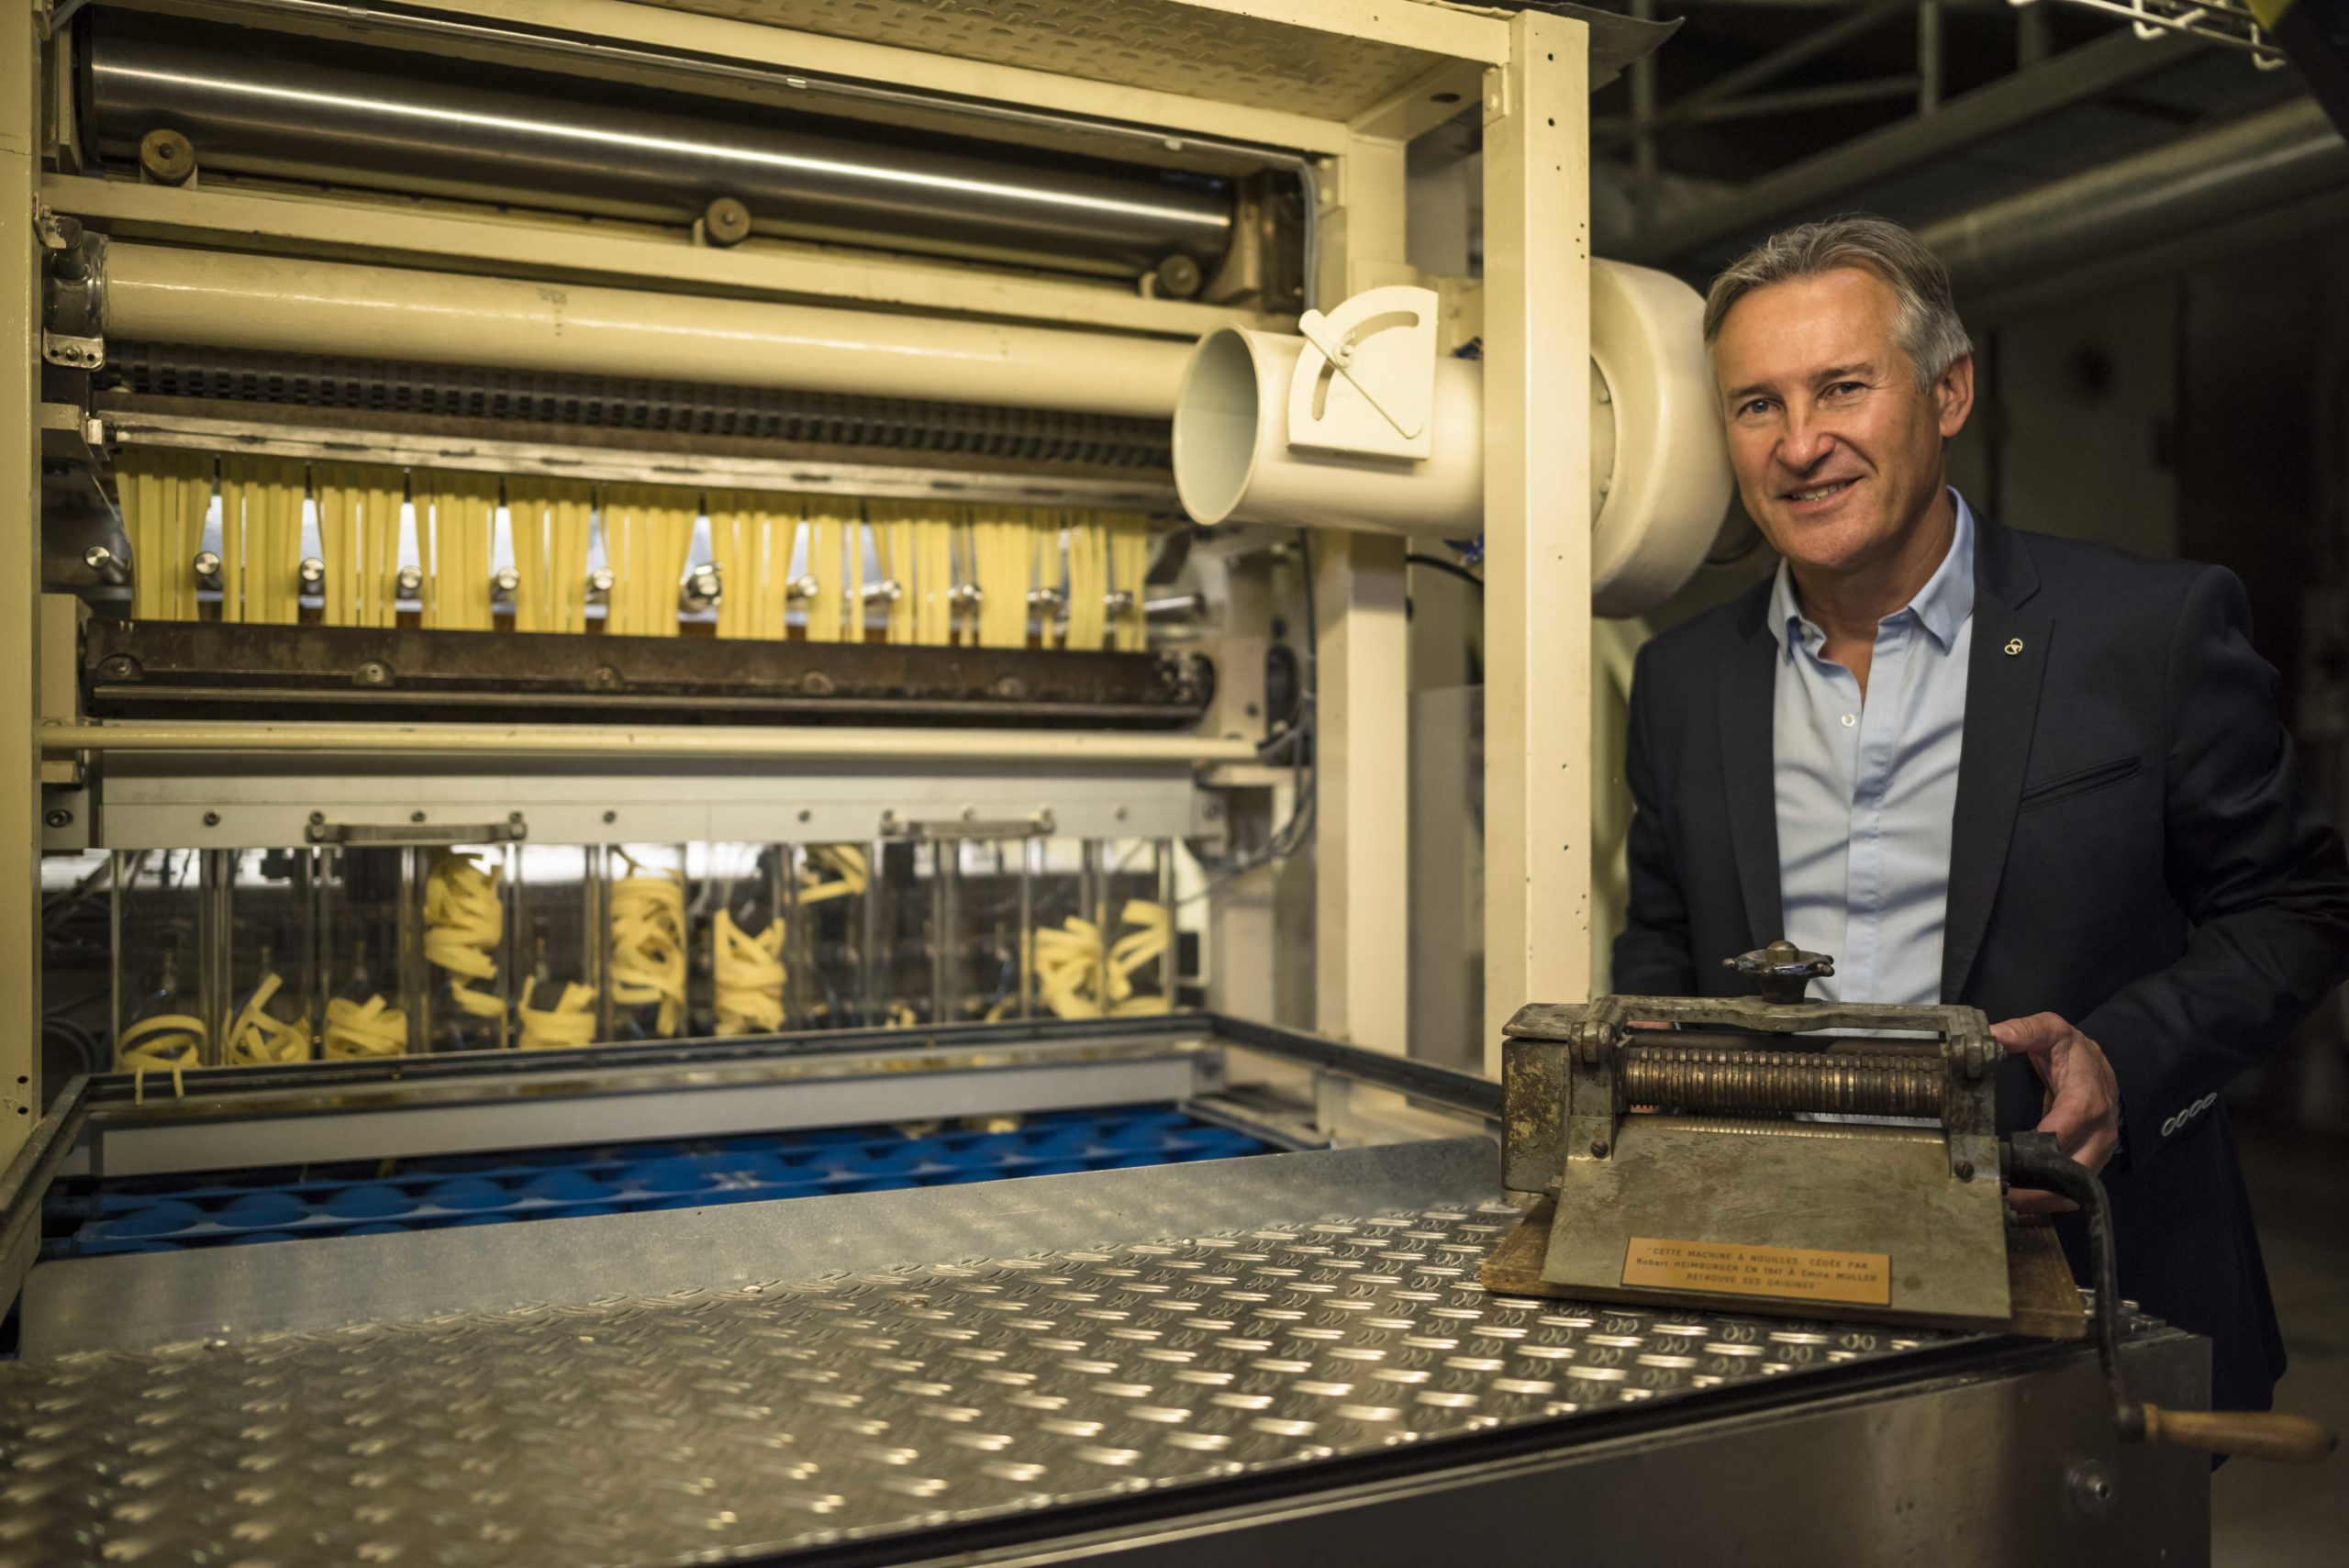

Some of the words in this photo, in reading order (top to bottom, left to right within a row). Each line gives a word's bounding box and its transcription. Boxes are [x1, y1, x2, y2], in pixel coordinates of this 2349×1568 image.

[1687, 1251, 1732, 1261] MACHINE
[1636, 1257, 1668, 1266] Robert
[1674, 1261, 1738, 1272] HEIMBURGER
[1744, 1265, 1757, 1273] EN
[1687, 1273, 1736, 1284] RETROUVE
[1742, 1276, 1761, 1285] SES
